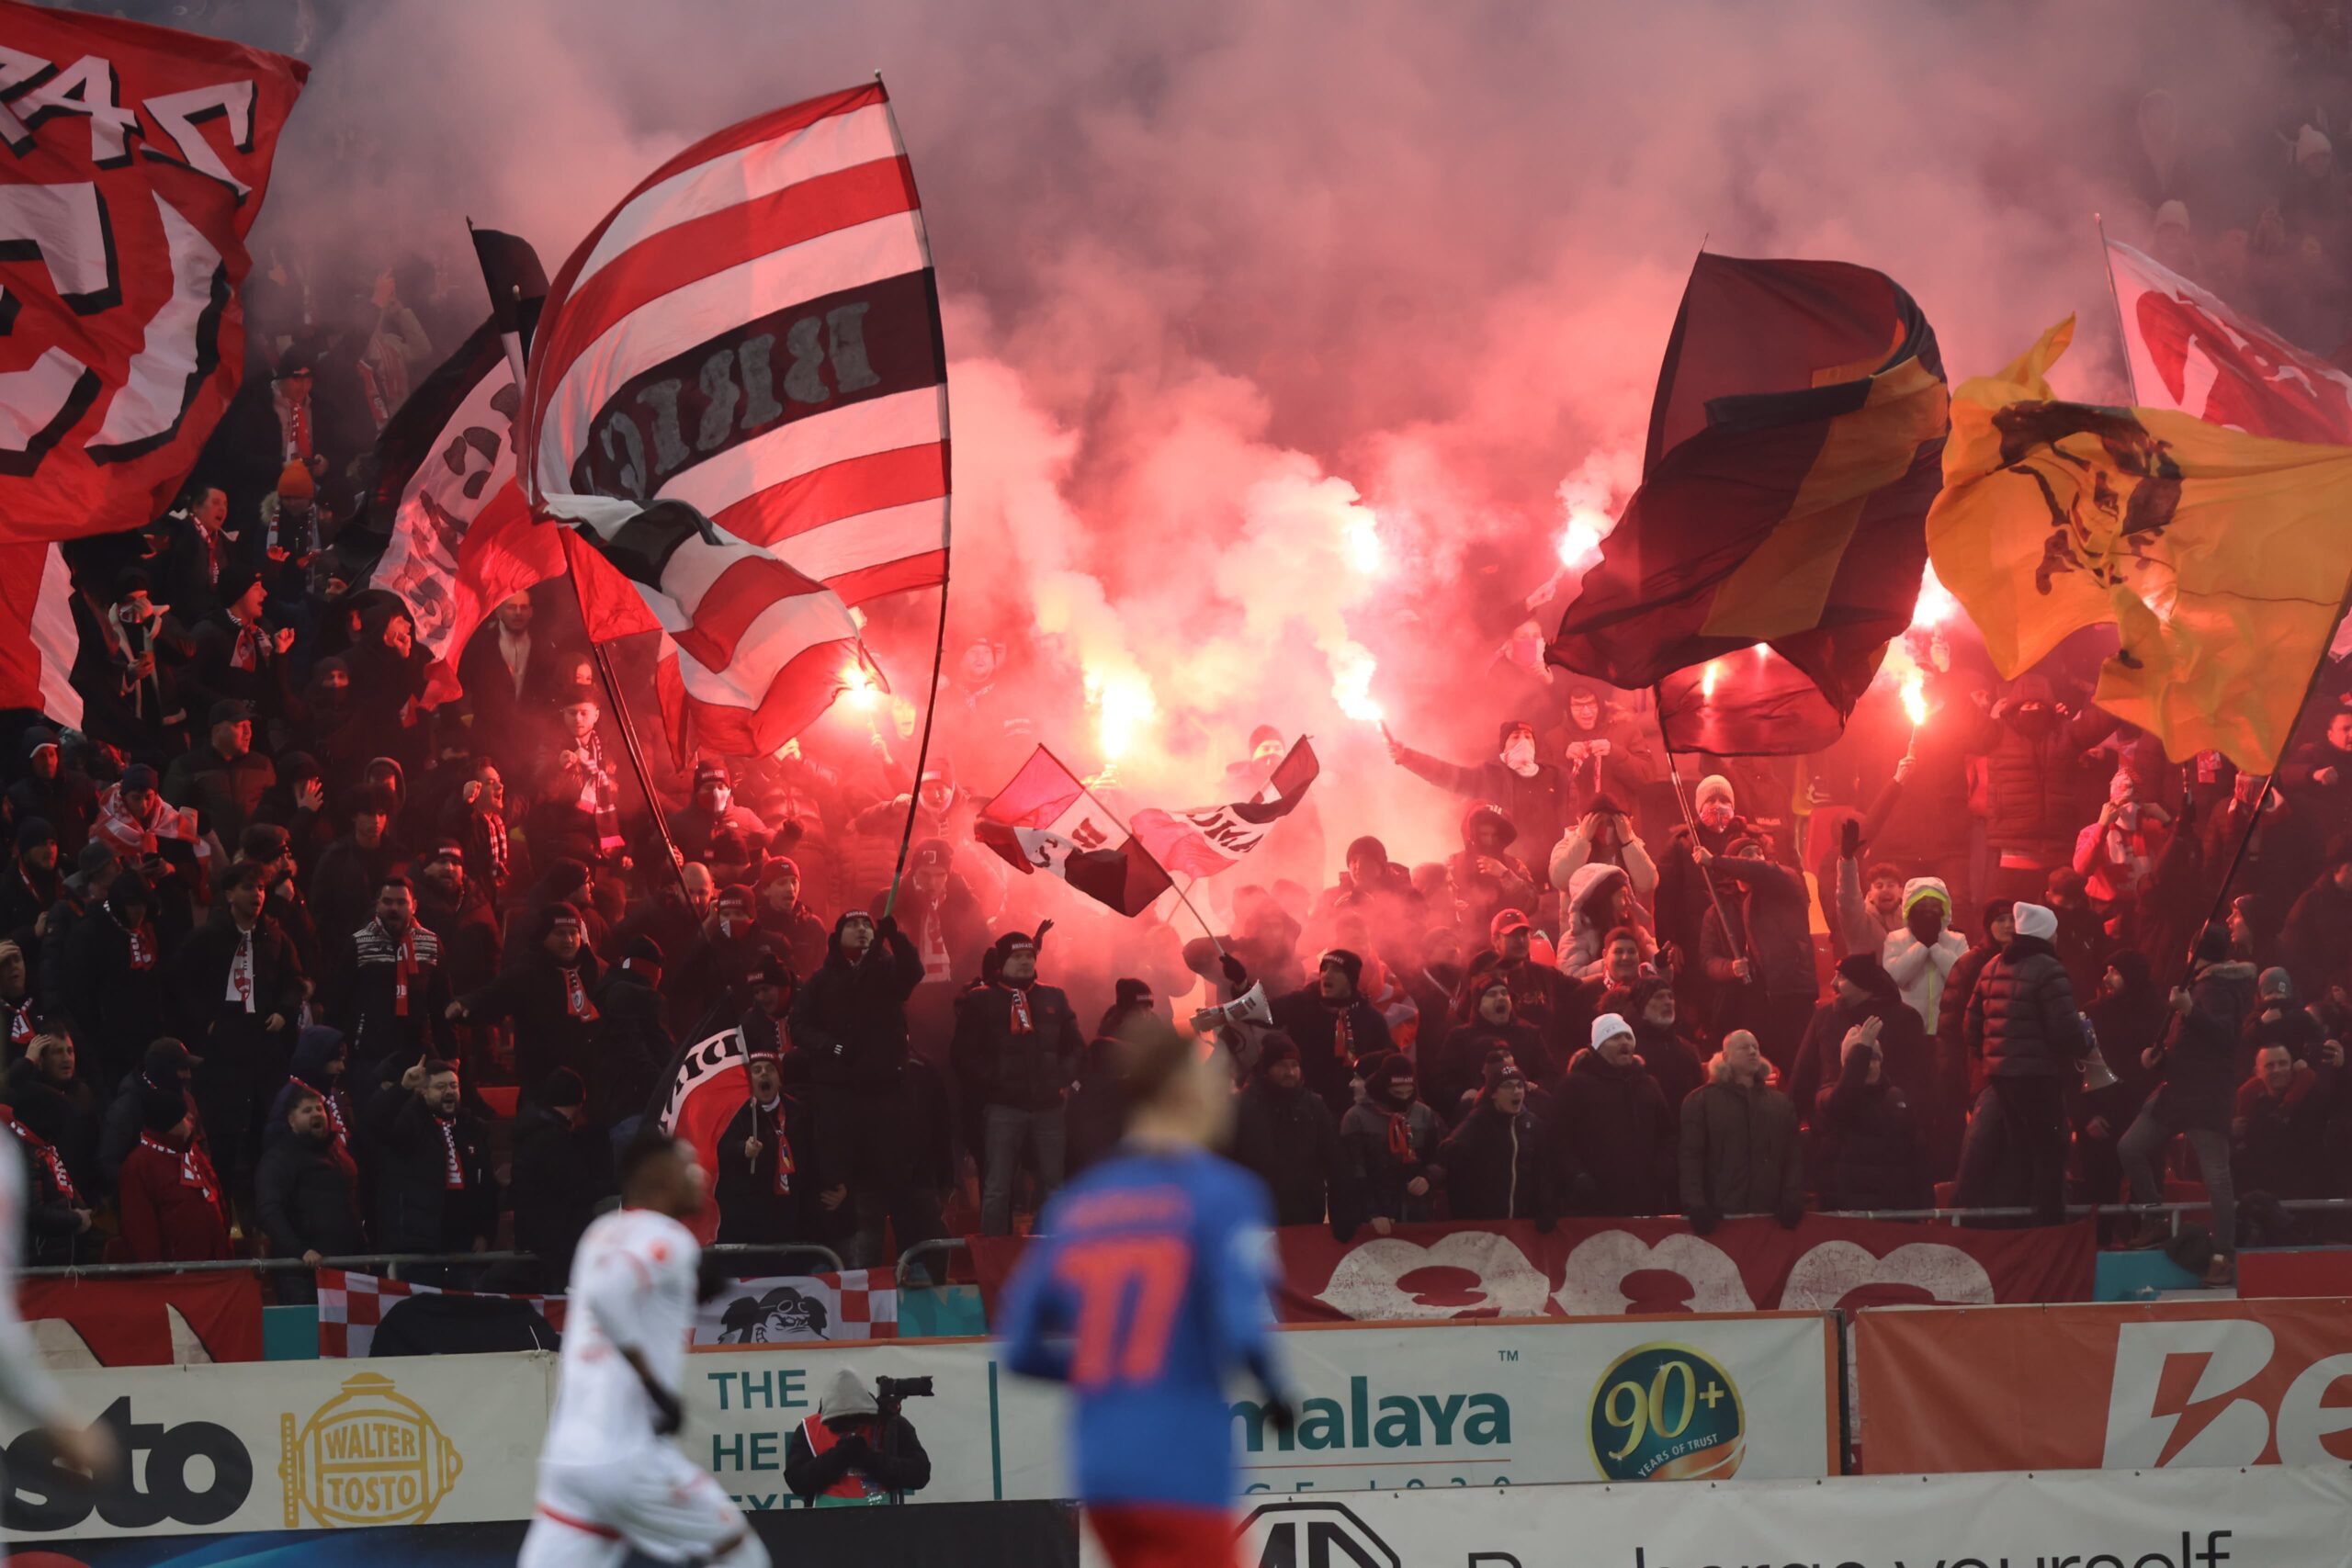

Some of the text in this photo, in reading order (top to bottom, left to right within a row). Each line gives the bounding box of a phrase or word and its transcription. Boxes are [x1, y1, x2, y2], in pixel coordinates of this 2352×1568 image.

[707, 1370, 808, 1410] THE
[1228, 1375, 1511, 1452] malaya
[324, 1423, 417, 1461] WALTER
[1637, 1433, 1719, 1478] YEARS OF TRUST
[0, 1395, 253, 1532] sto
[326, 1474, 418, 1512] TOSTO
